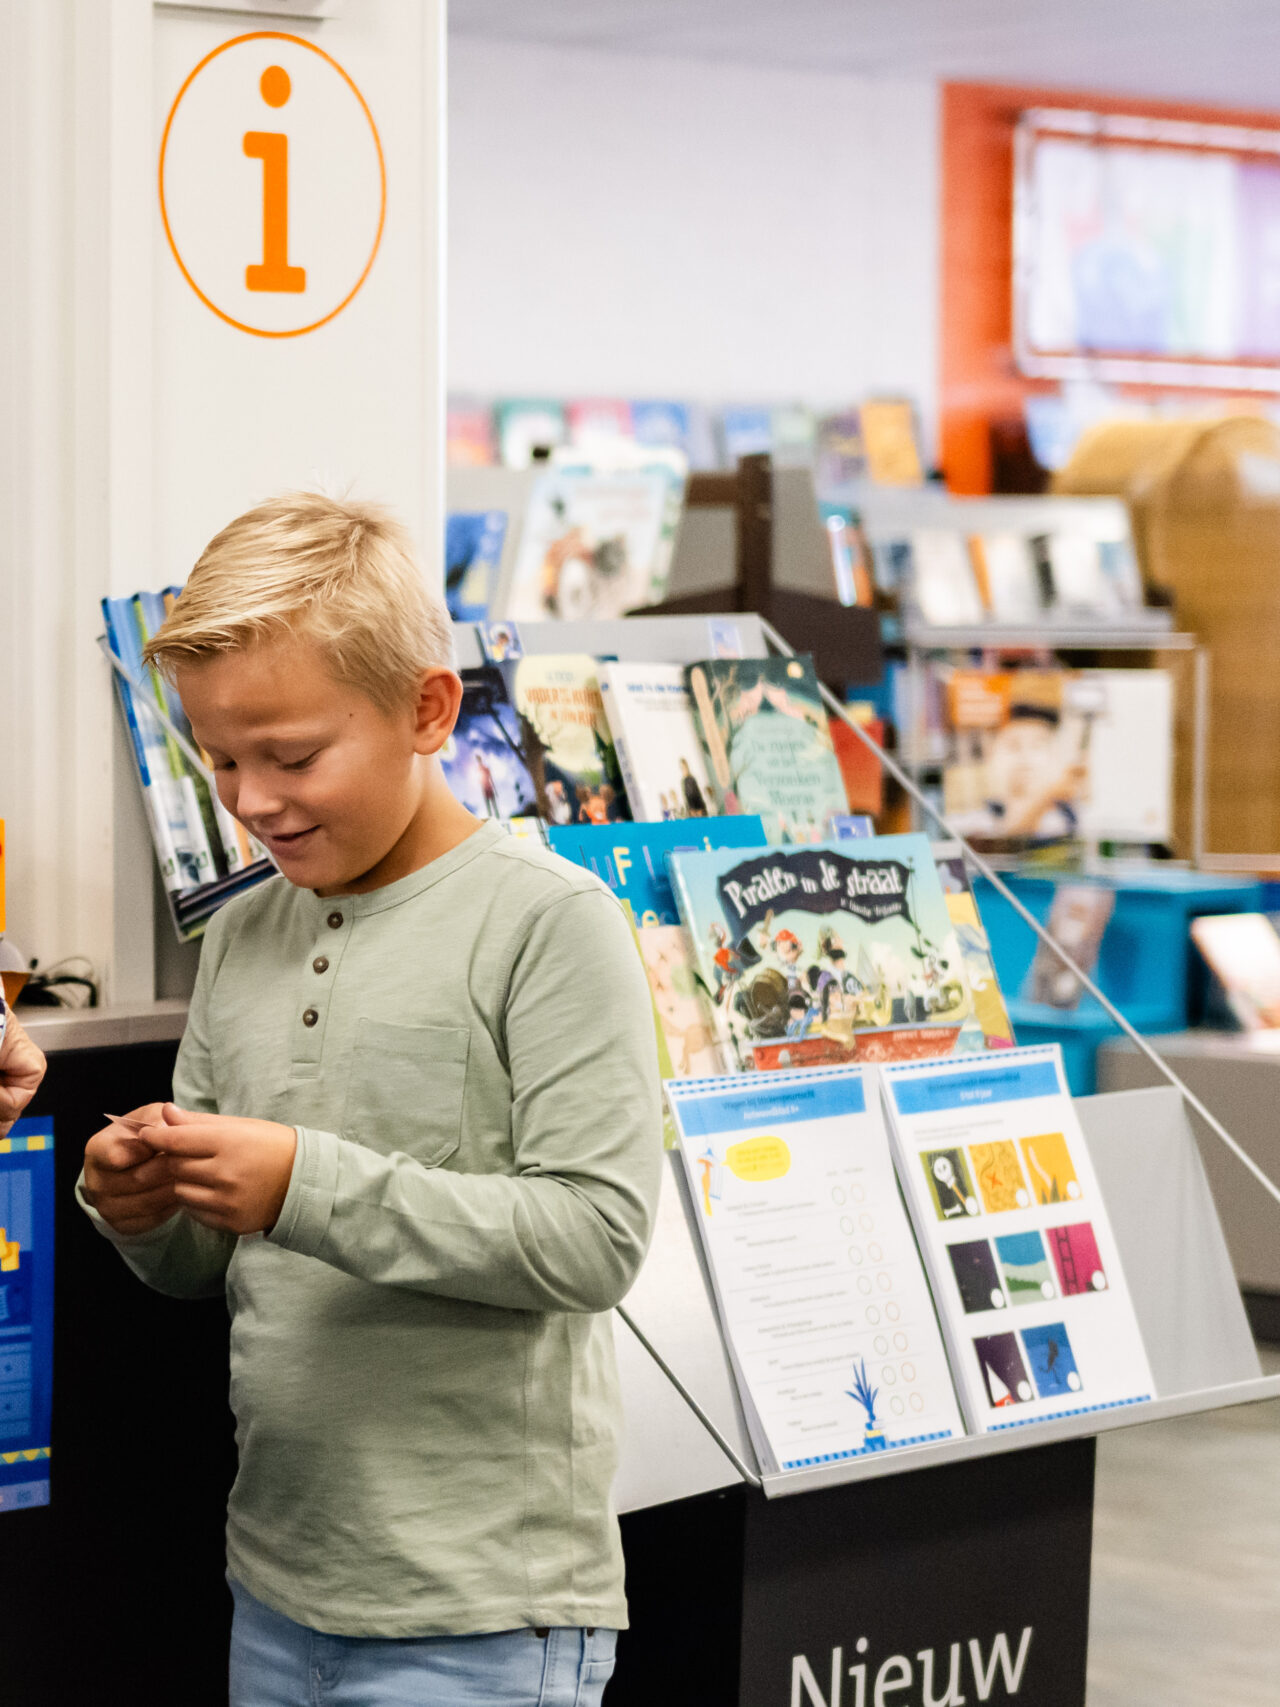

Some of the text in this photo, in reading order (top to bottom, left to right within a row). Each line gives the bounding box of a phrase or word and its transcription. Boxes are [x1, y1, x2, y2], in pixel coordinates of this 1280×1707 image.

[723, 859, 904, 918] Piraten in de straat
[791, 1626, 1033, 1707] Nieuw
